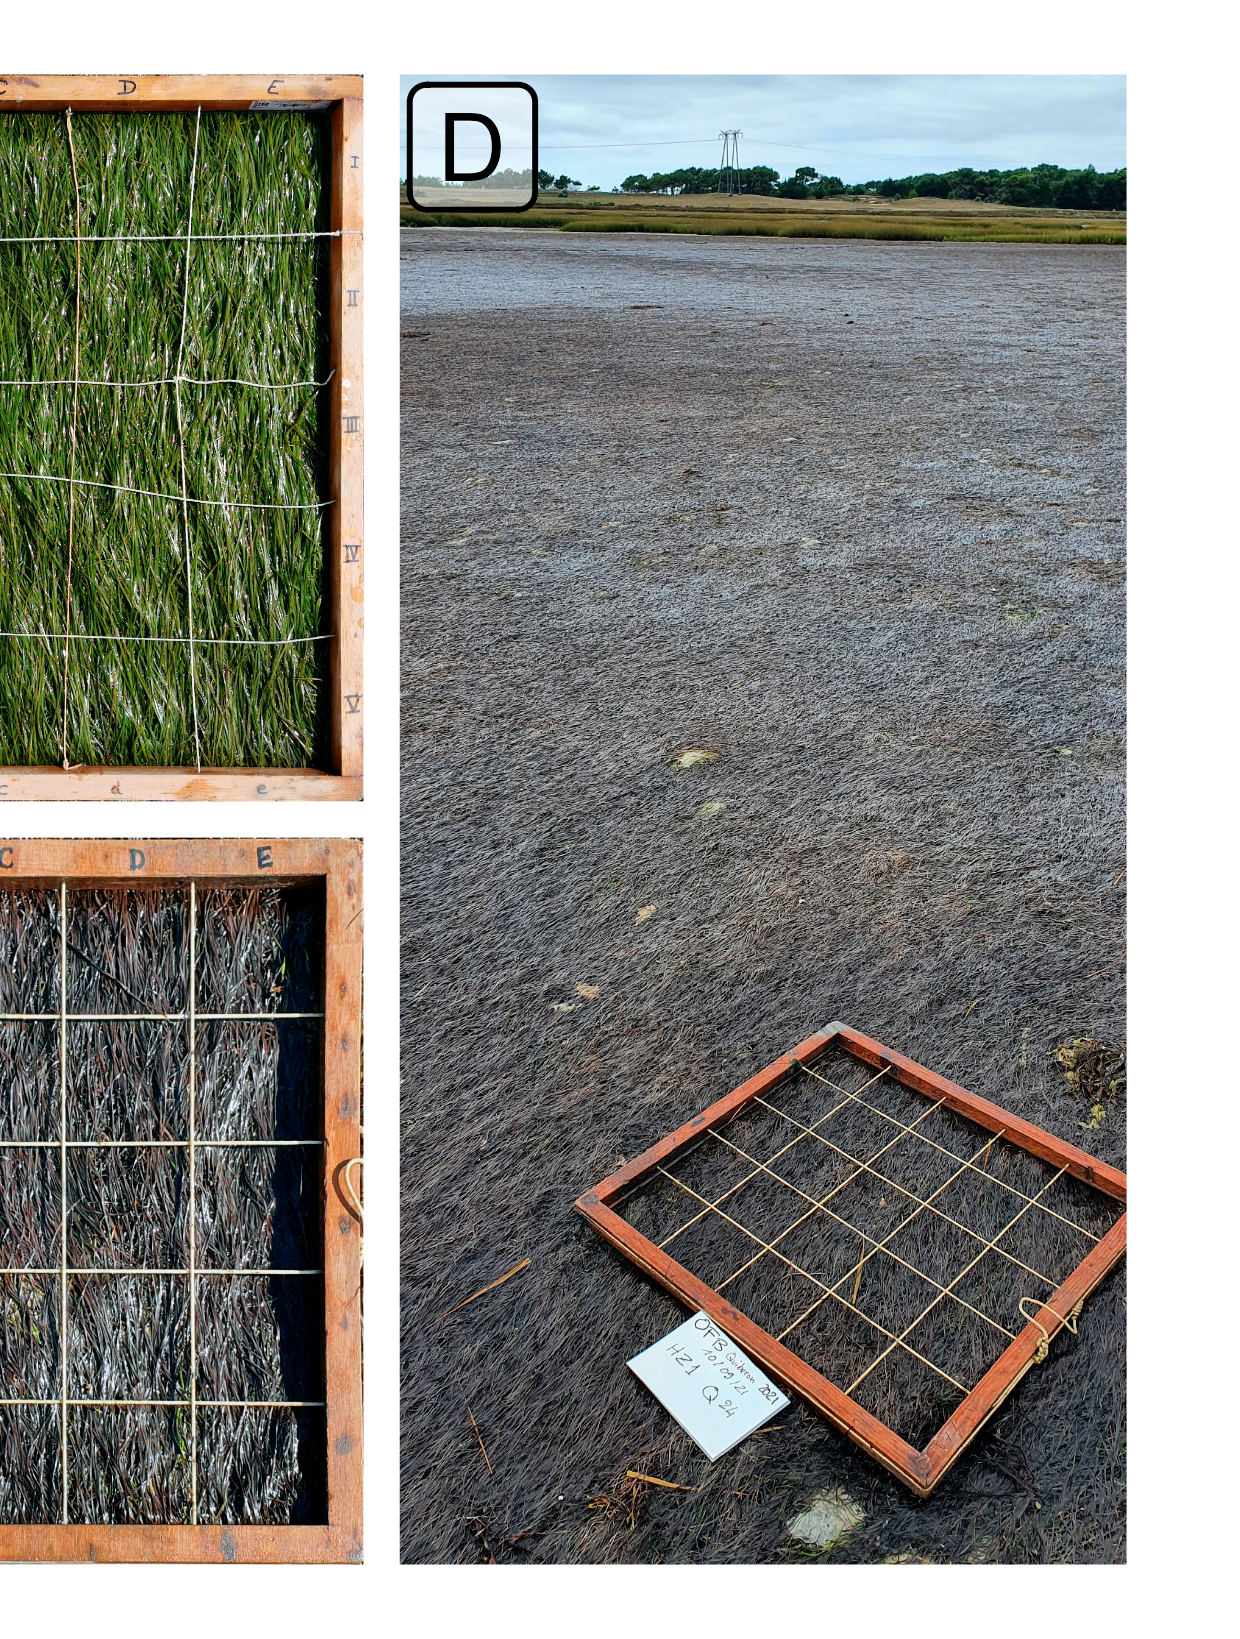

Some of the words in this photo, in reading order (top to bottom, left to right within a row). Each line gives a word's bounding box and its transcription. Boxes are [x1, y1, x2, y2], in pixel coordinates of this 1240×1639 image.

[117, 79, 137, 95] D
[267, 79, 285, 95] E
[343, 544, 361, 563] IV
[343, 693, 363, 714] V
[110, 780, 124, 795] d
[256, 784, 269, 795] e
[129, 848, 146, 870] D
[256, 846, 274, 869] E
[666, 1343, 700, 1376] HZ1
[694, 1318, 728, 1352] OFB
[726, 1352, 756, 1384] Quiberon
[758, 1383, 780, 1405] 2021
